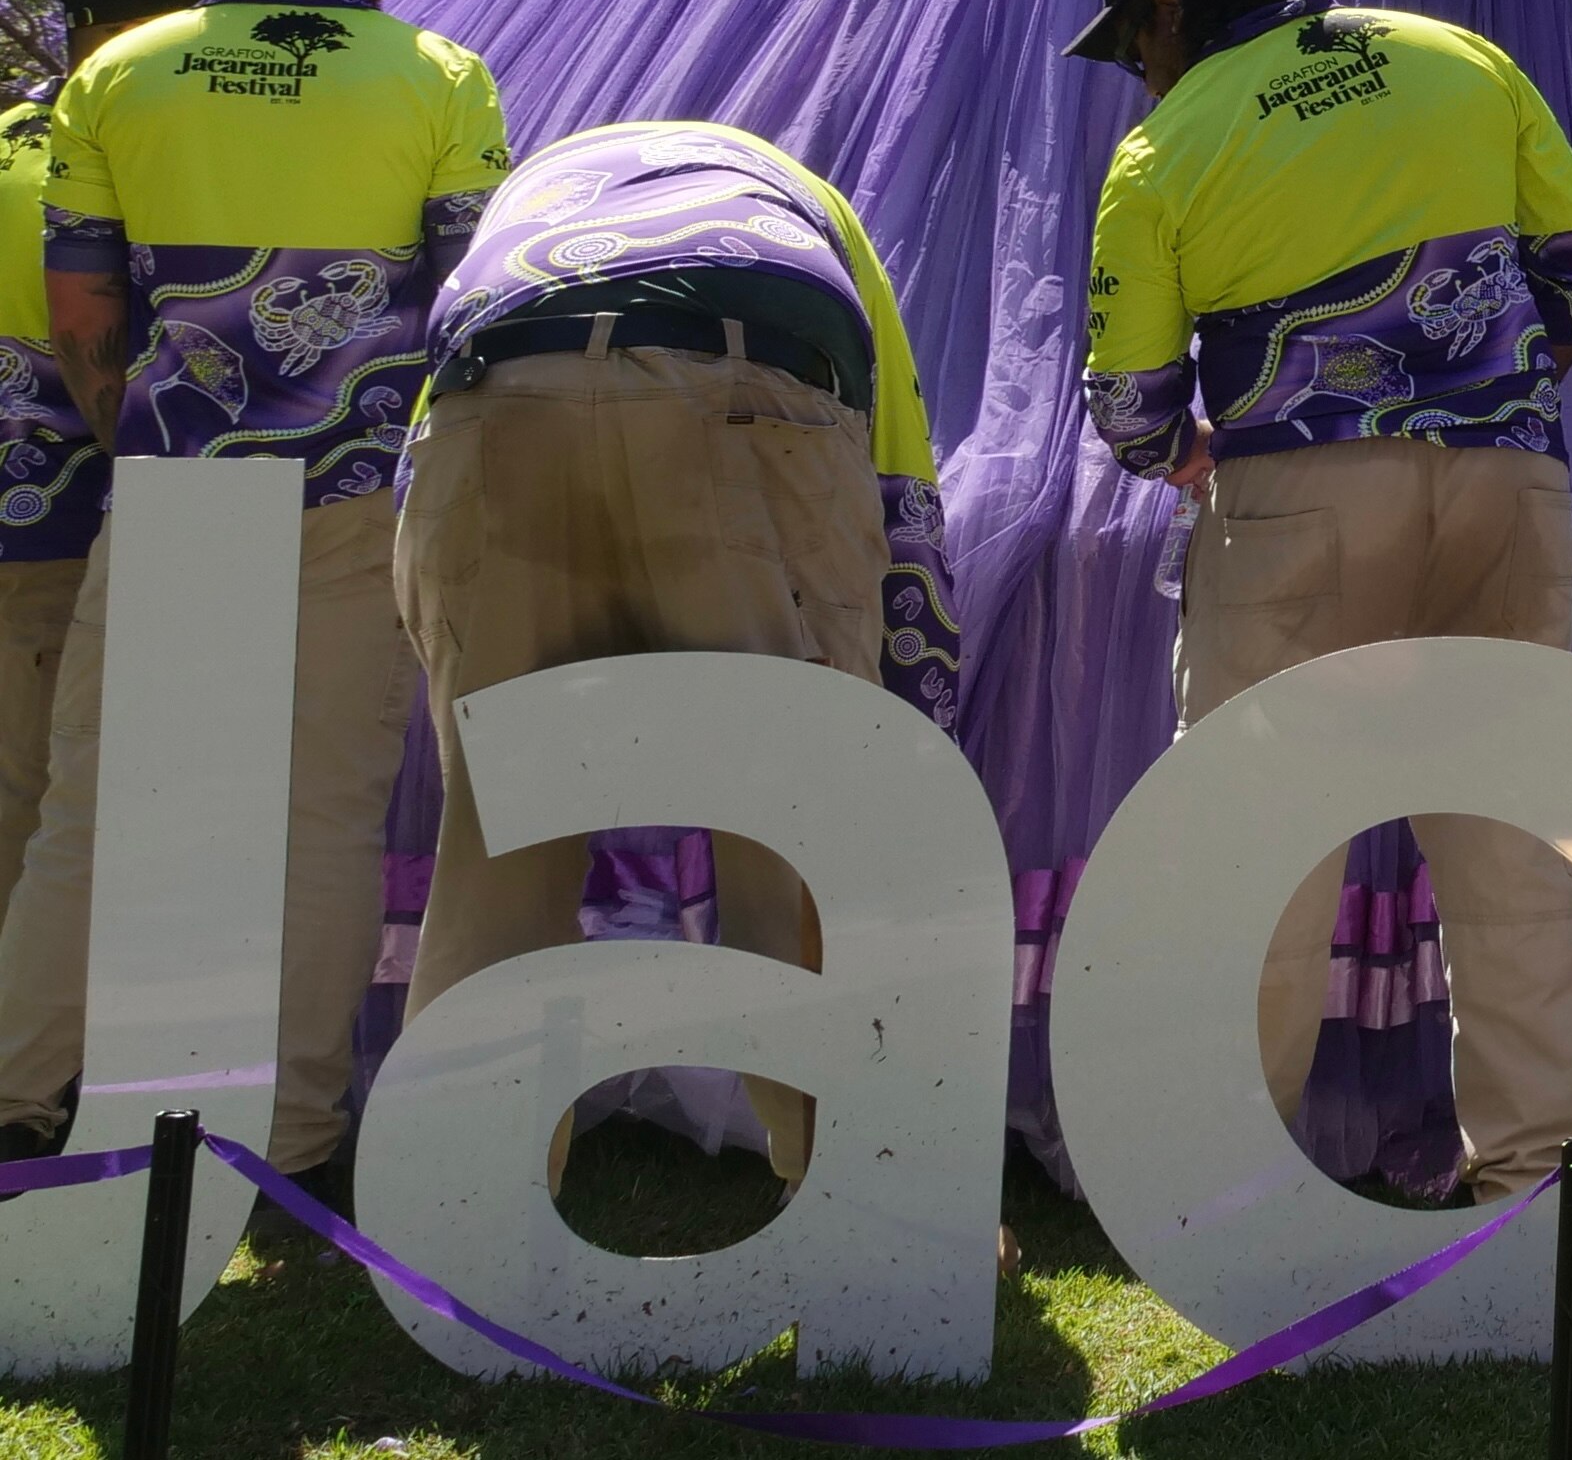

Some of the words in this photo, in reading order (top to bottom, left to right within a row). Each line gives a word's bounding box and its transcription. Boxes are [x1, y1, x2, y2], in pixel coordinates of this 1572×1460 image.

[174, 52, 318, 77] Jacaranda
[201, 46, 276, 60] GRAFTON
[207, 75, 302, 97] Festival
[1256, 51, 1391, 120] Jacaranda
[1269, 56, 1339, 90] GRAFTON
[1292, 70, 1388, 122] Festival
